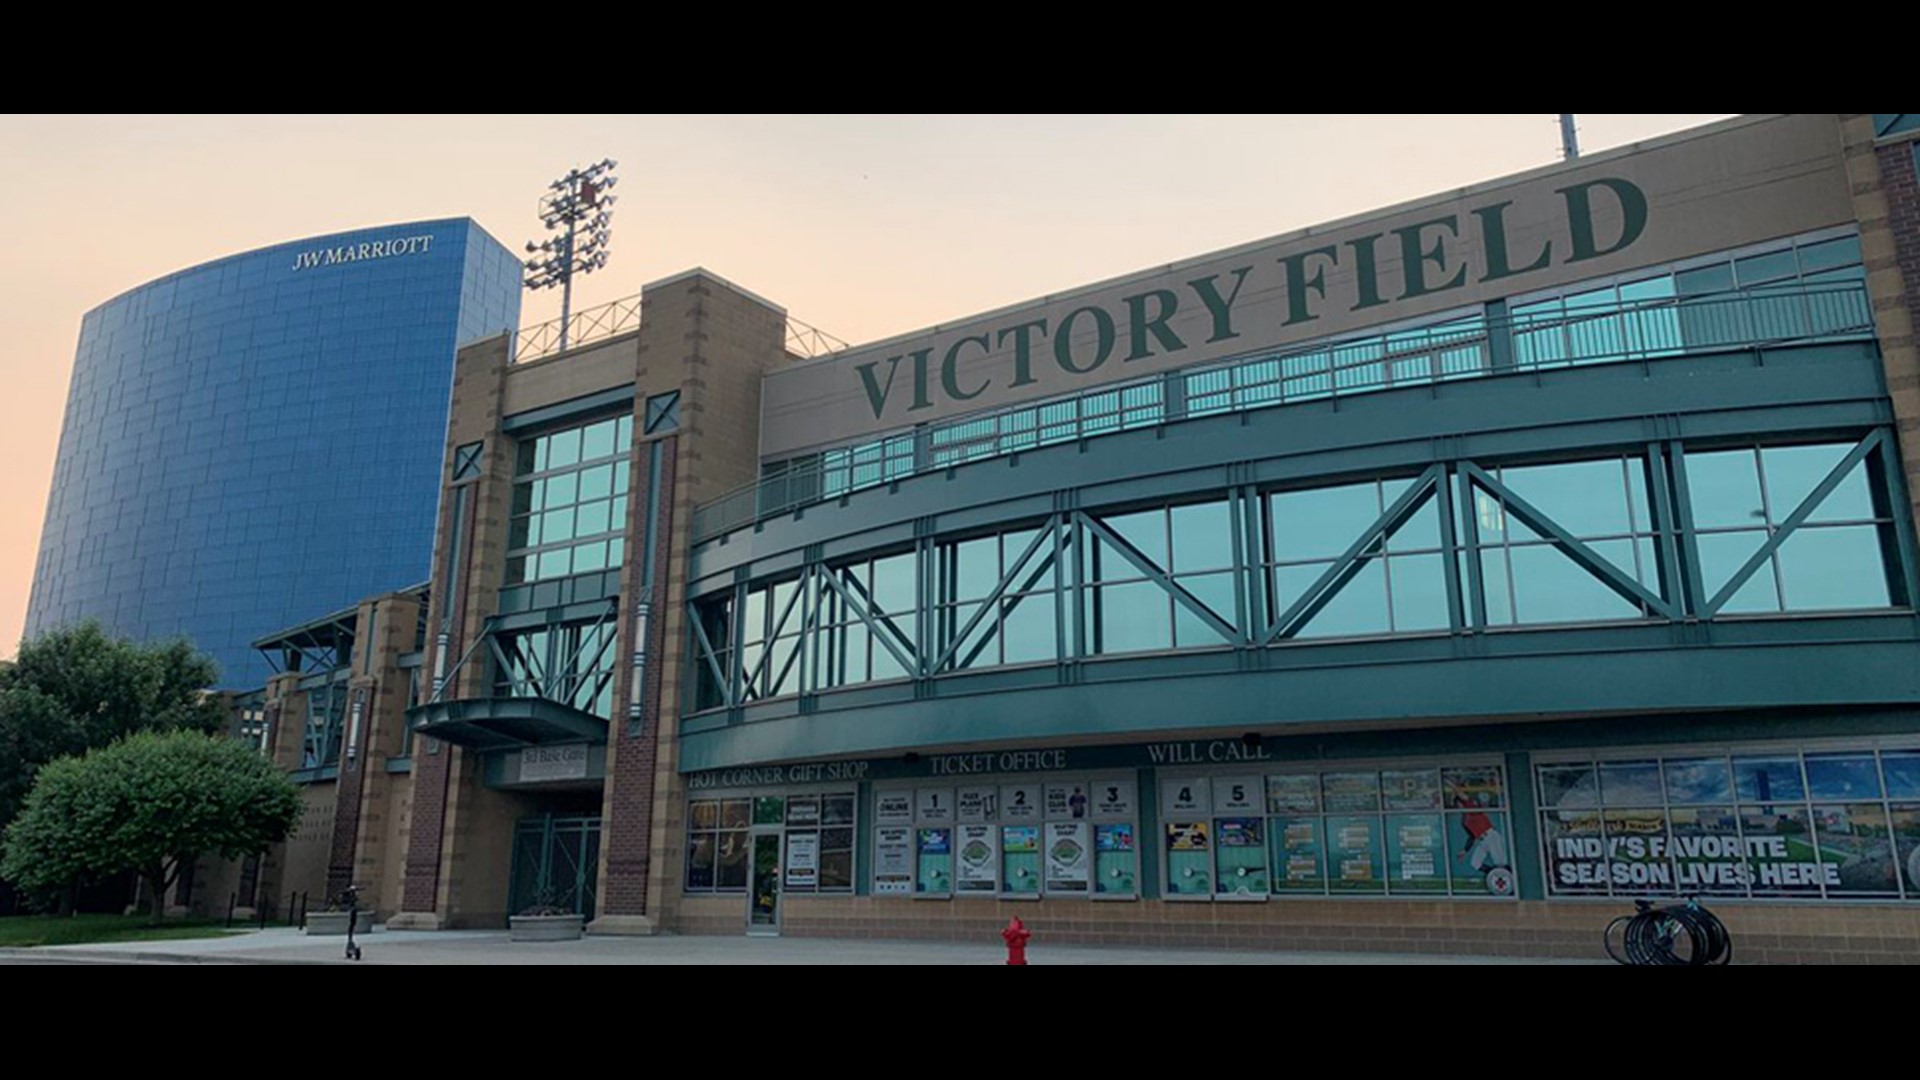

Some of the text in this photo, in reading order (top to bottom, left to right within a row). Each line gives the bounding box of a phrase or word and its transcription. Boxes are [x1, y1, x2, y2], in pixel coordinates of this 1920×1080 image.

[292, 235, 434, 271] JW MARRIOTT
[854, 177, 1648, 421] VICTORY FIELD
[931, 750, 1067, 774] TICKET OFFICE
[1147, 741, 1270, 764] WILL CALL
[689, 761, 869, 788] HOT CORNER GIFT SHOP
[931, 794, 938, 808] 1
[1015, 790, 1026, 805] 2
[1107, 787, 1118, 802] 3
[1178, 787, 1192, 802] 4
[1232, 785, 1244, 801] 5
[1556, 836, 1787, 858] INDY'S FAVORITE
[1559, 862, 1841, 885] SEASON LIVES HERE
